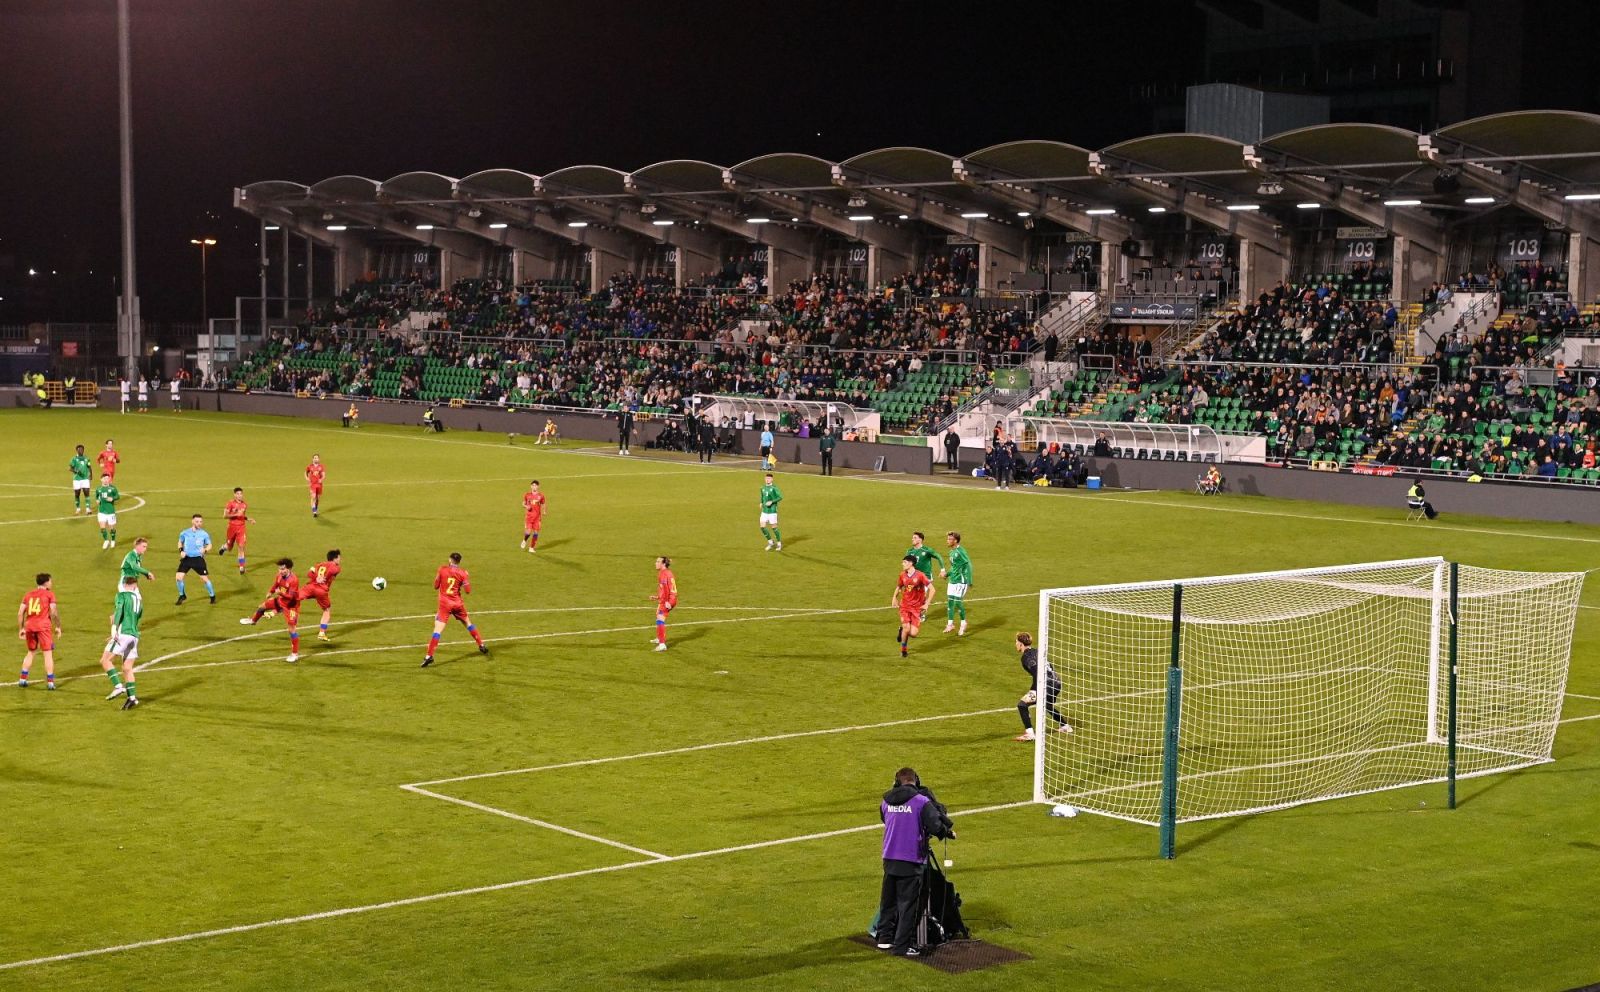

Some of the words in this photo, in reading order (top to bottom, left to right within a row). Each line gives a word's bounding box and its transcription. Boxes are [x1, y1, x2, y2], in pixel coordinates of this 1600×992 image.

[848, 248, 867, 261] 102
[1201, 243, 1225, 258] 103
[1347, 242, 1374, 257] 103
[1508, 239, 1538, 256] 103
[413, 252, 428, 263] 101
[446, 577, 456, 594] 2
[28, 597, 41, 615] 14
[131, 594, 140, 613] 11
[887, 805, 912, 814] MEDIA
